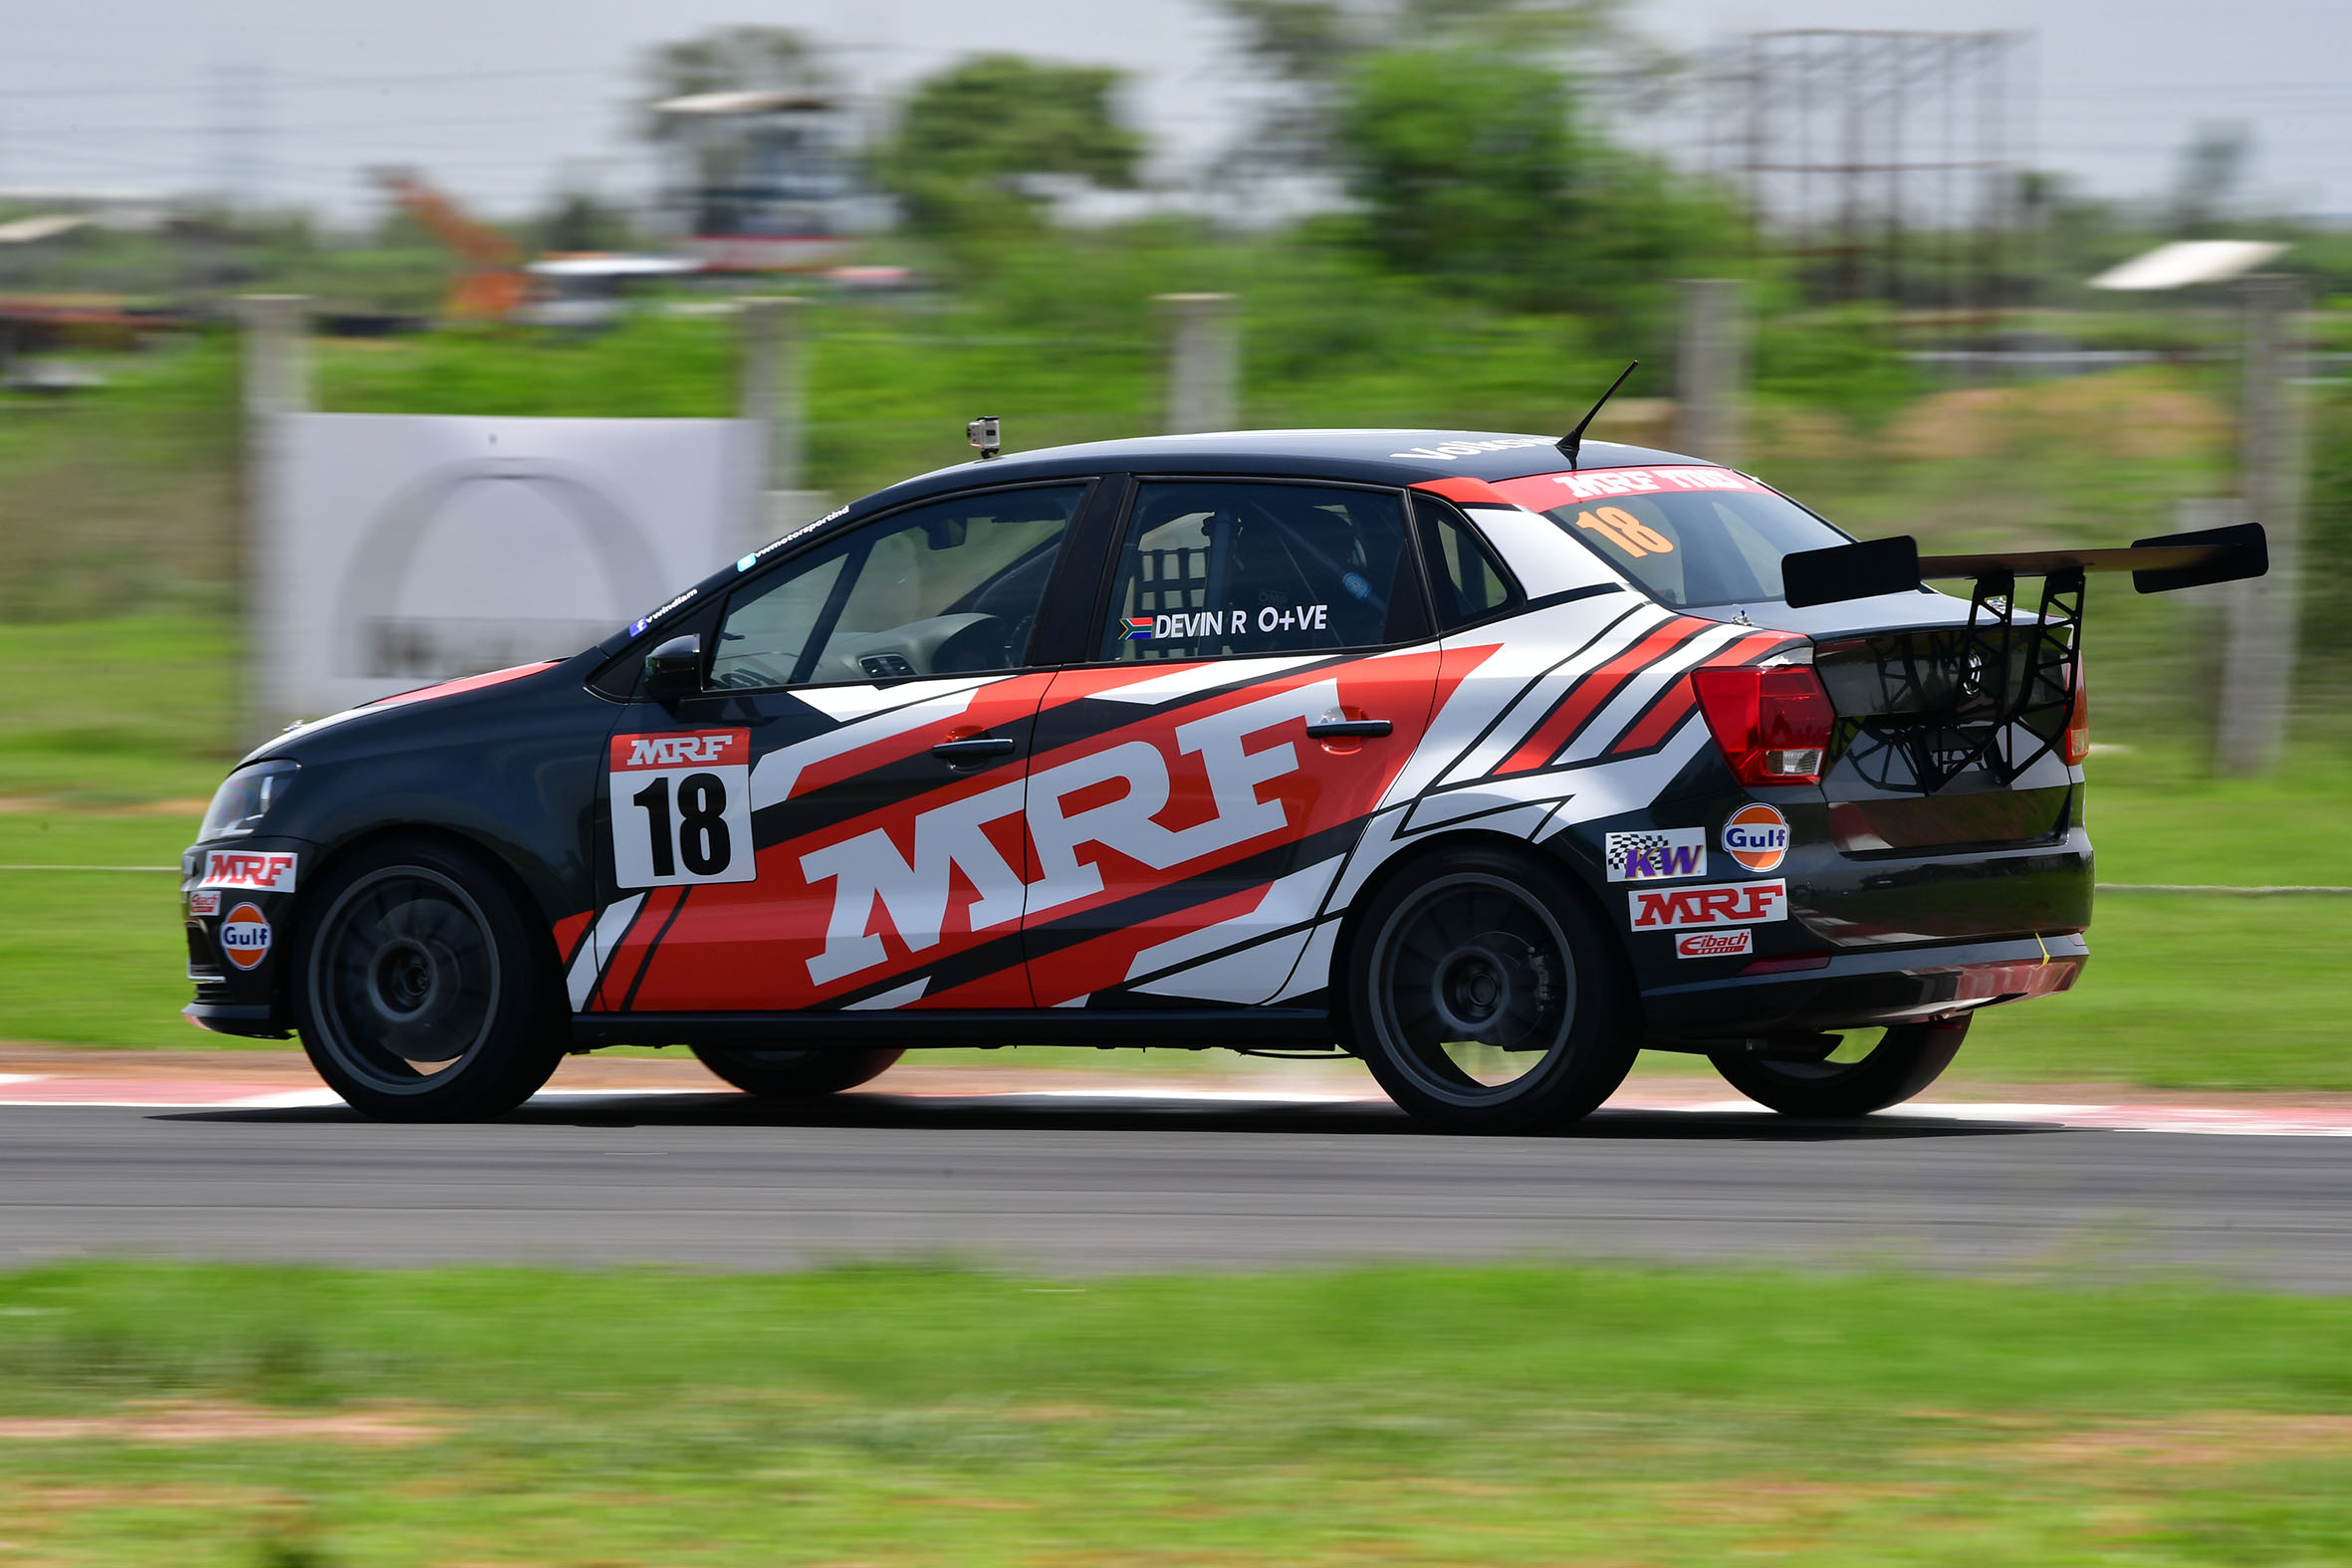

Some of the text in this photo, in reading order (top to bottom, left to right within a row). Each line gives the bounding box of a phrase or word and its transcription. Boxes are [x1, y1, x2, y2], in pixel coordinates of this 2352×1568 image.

[1551, 470, 1661, 498] MRF
[755, 505, 849, 559] vwmotorsportind
[1575, 506, 1674, 558] 18
[1155, 604, 1328, 639] DEVIN R O+VE
[627, 735, 733, 766] MRF
[633, 773, 731, 876] 18
[799, 677, 1346, 986] MRF
[1726, 827, 1785, 848] Gulf
[204, 854, 293, 887] MRF
[1624, 844, 1704, 879] KW
[1634, 885, 1783, 927] MRF
[223, 926, 268, 946] Gulf
[1679, 932, 1750, 956] Eibach
